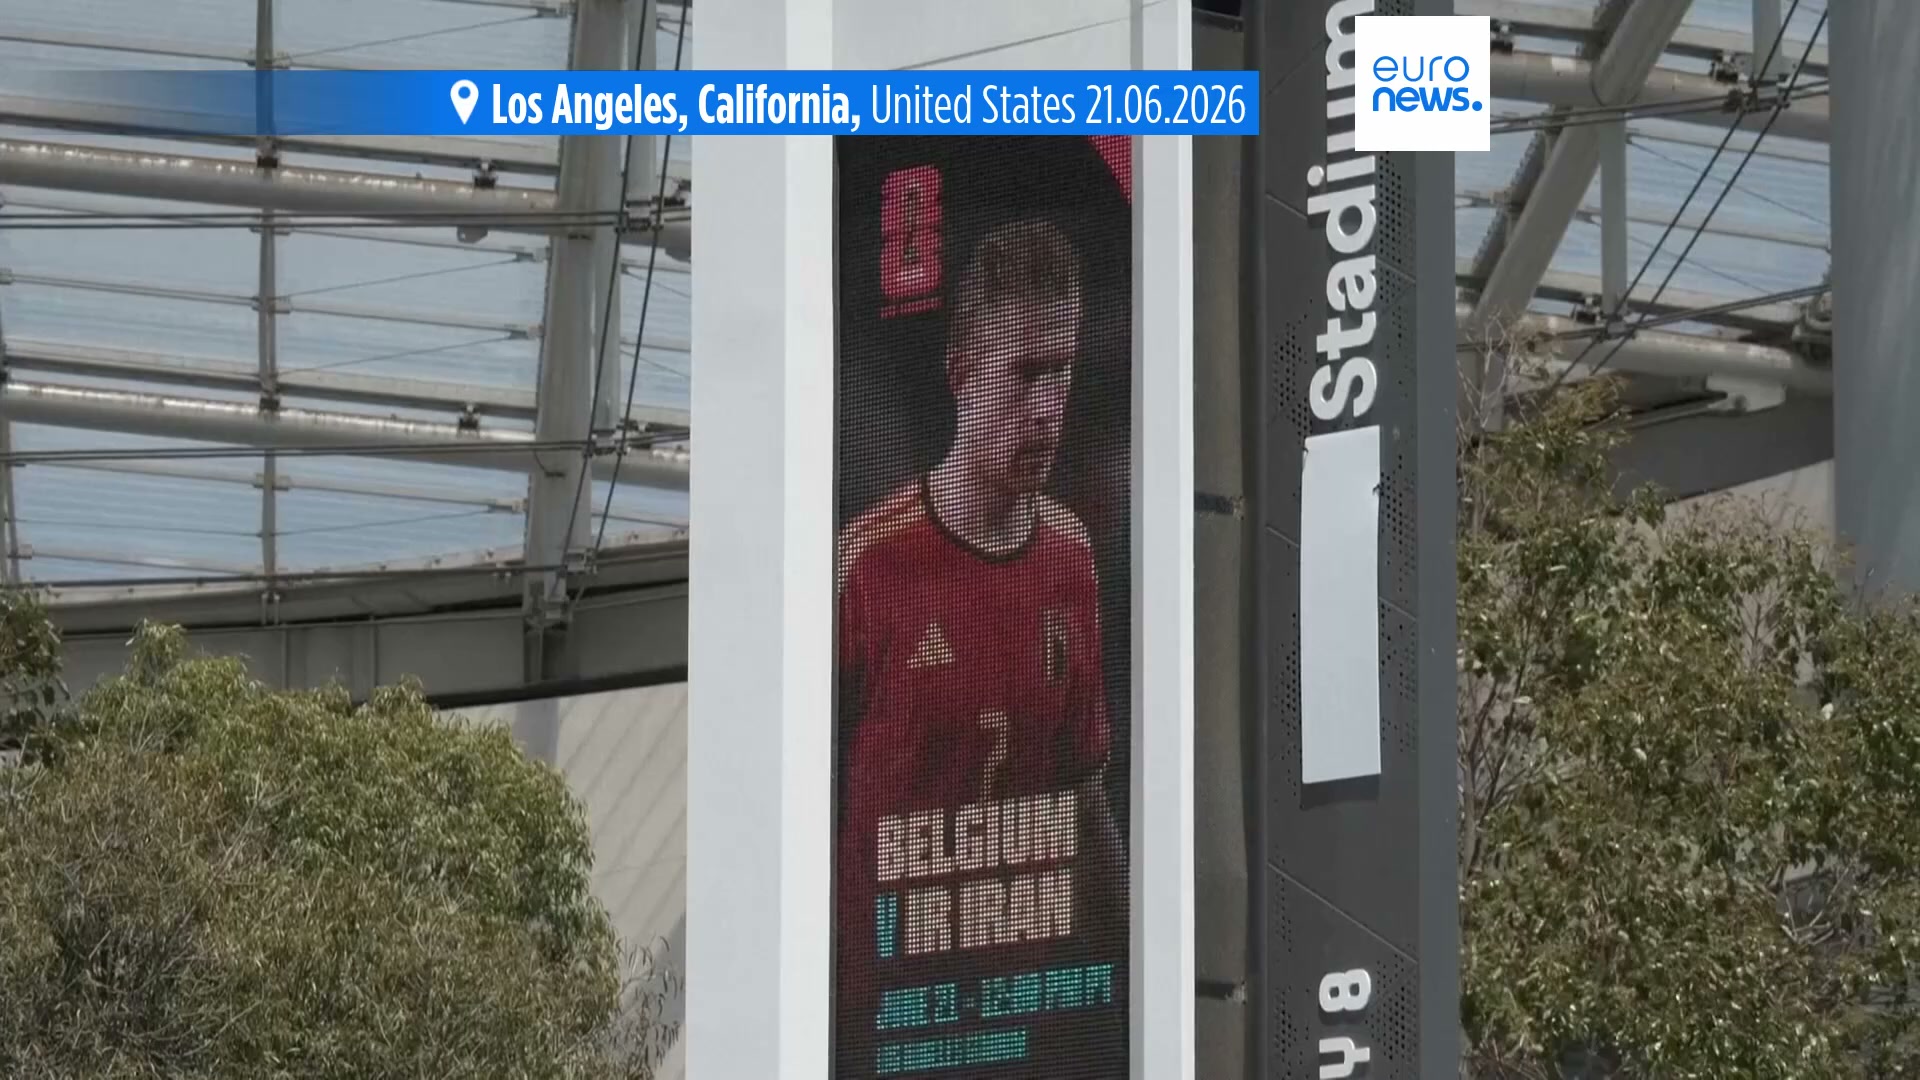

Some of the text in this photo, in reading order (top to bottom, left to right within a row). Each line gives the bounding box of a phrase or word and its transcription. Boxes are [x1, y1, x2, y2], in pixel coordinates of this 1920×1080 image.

[877, 790, 1078, 882] BELGIUM
[904, 885, 952, 954] IR
[958, 868, 1074, 949] IRAN
[1319, 968, 1372, 1012] 8
